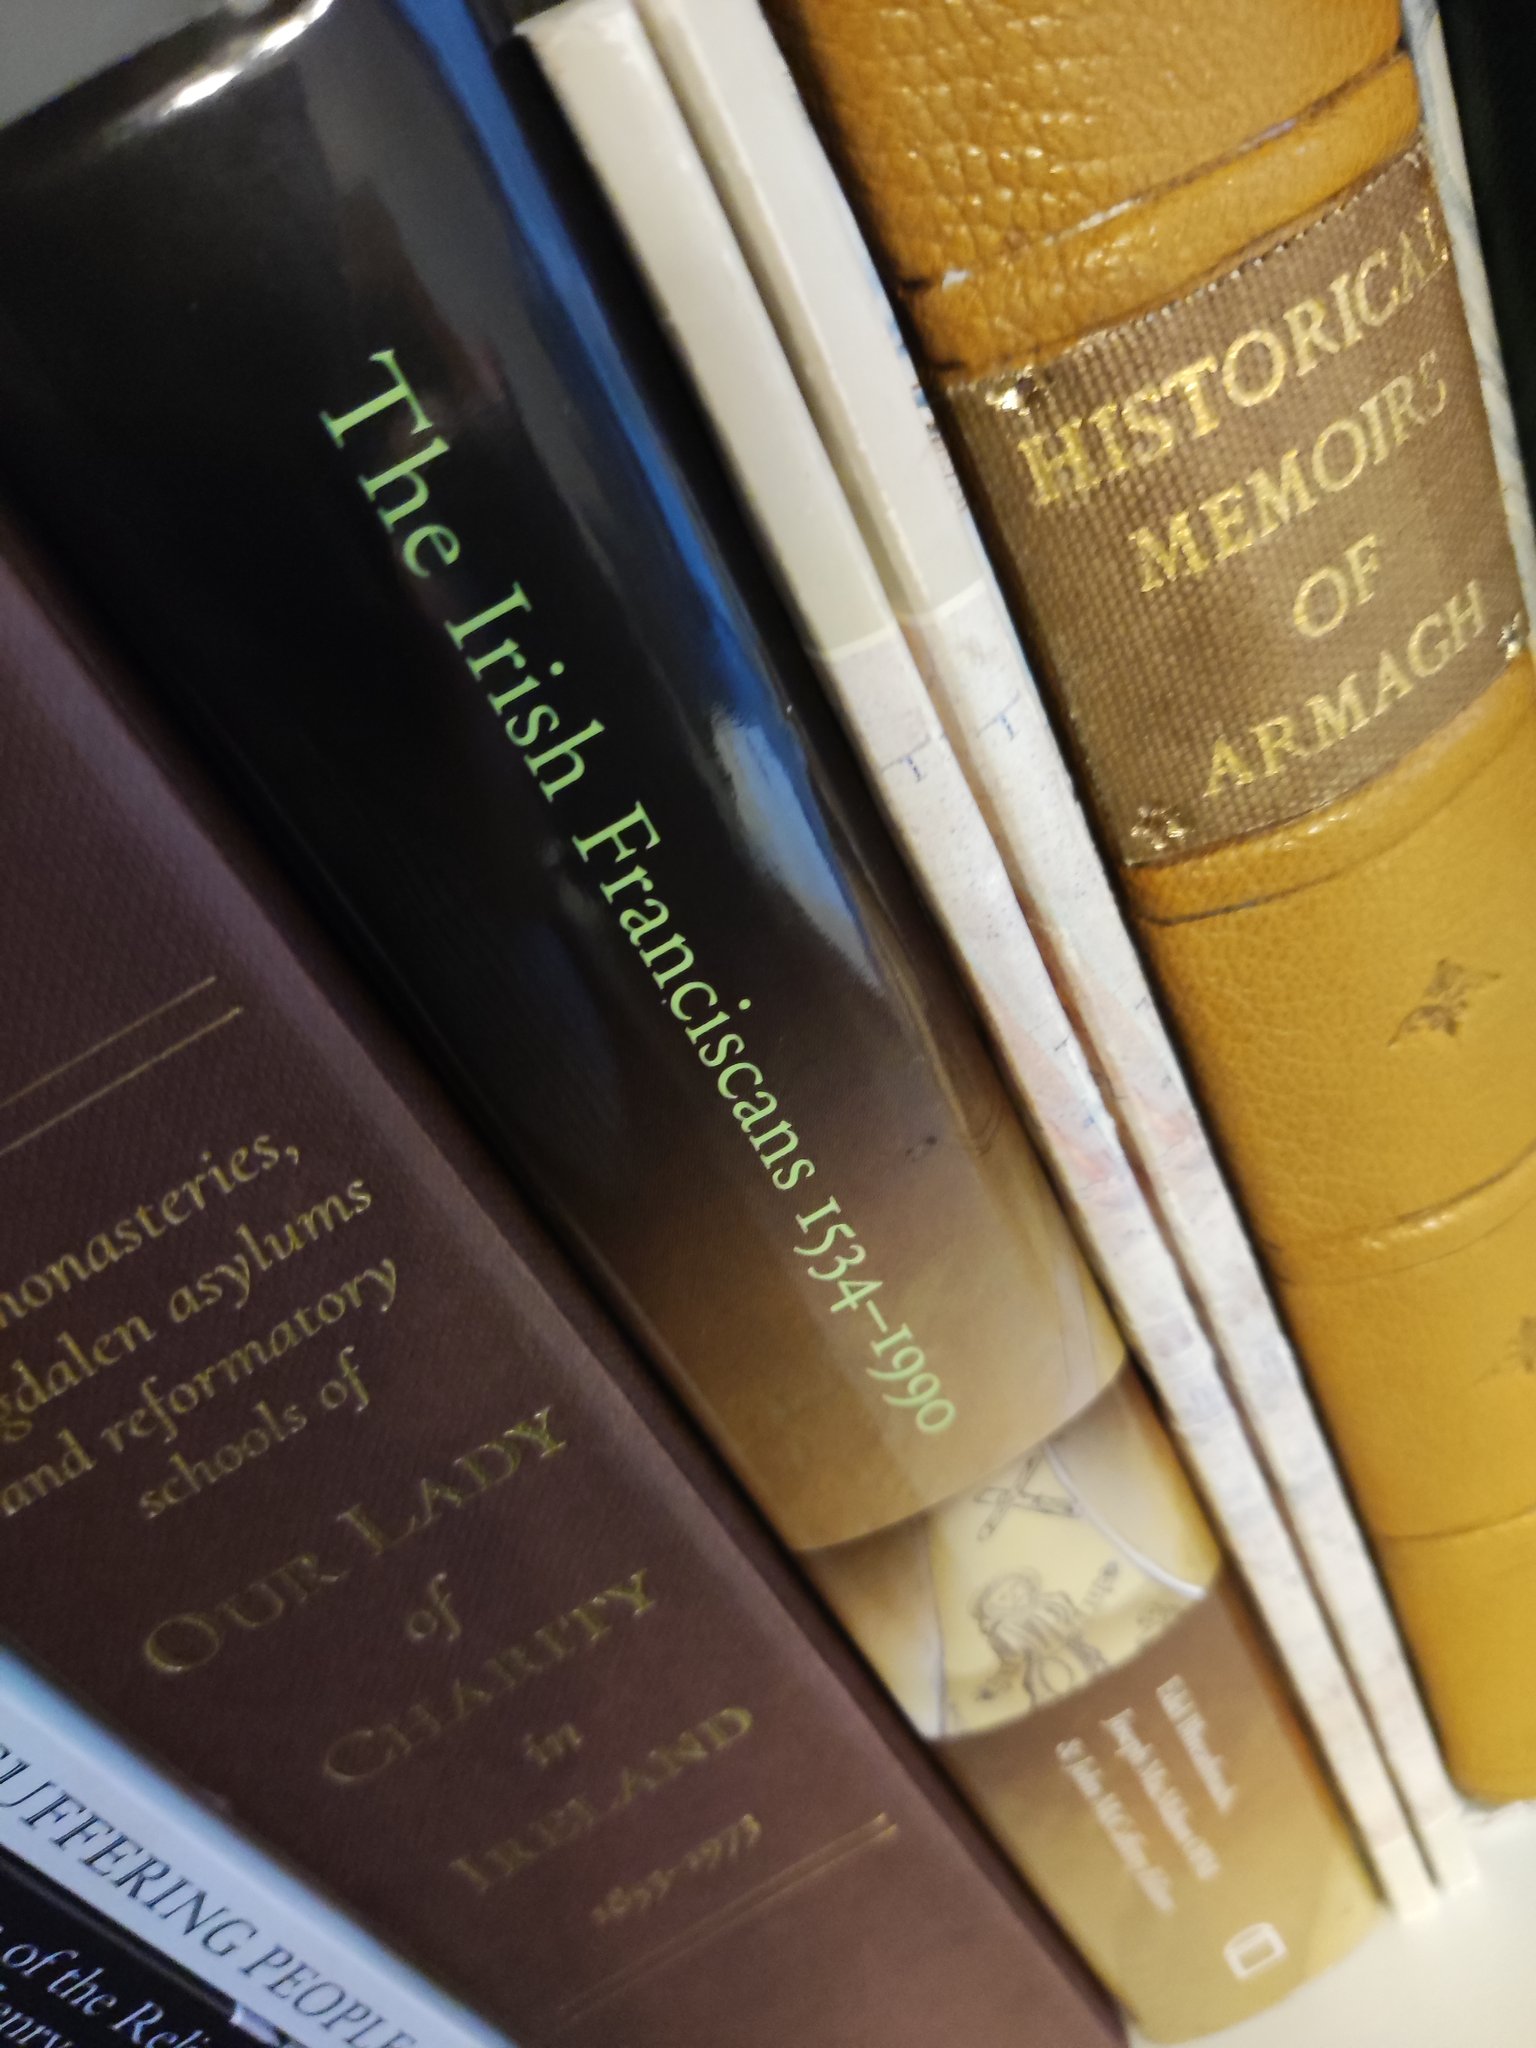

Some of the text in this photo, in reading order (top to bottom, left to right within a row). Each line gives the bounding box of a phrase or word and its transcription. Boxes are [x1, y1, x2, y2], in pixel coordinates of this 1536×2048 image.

[1017, 207, 1449, 505] HISTORICAL
[1128, 351, 1447, 592] MEMOIRS
[1203, 579, 1488, 797] ARMAGH
[1293, 533, 1385, 638] OF
[320, 349, 957, 1435] The Irish Franciscans 1534–1990
[168, 1178, 373, 1323] asylums
[1, 1258, 398, 1516] and reformatory
[139, 1345, 371, 1519] schools of
[143, 1405, 568, 1674] OUR LADY
[407, 1572, 462, 1642] of
[0, 1741, 259, 1956] UFFERING
[523, 1722, 584, 1771] in
[2, 1943, 79, 1977] of
[47, 1967, 118, 2016] the
